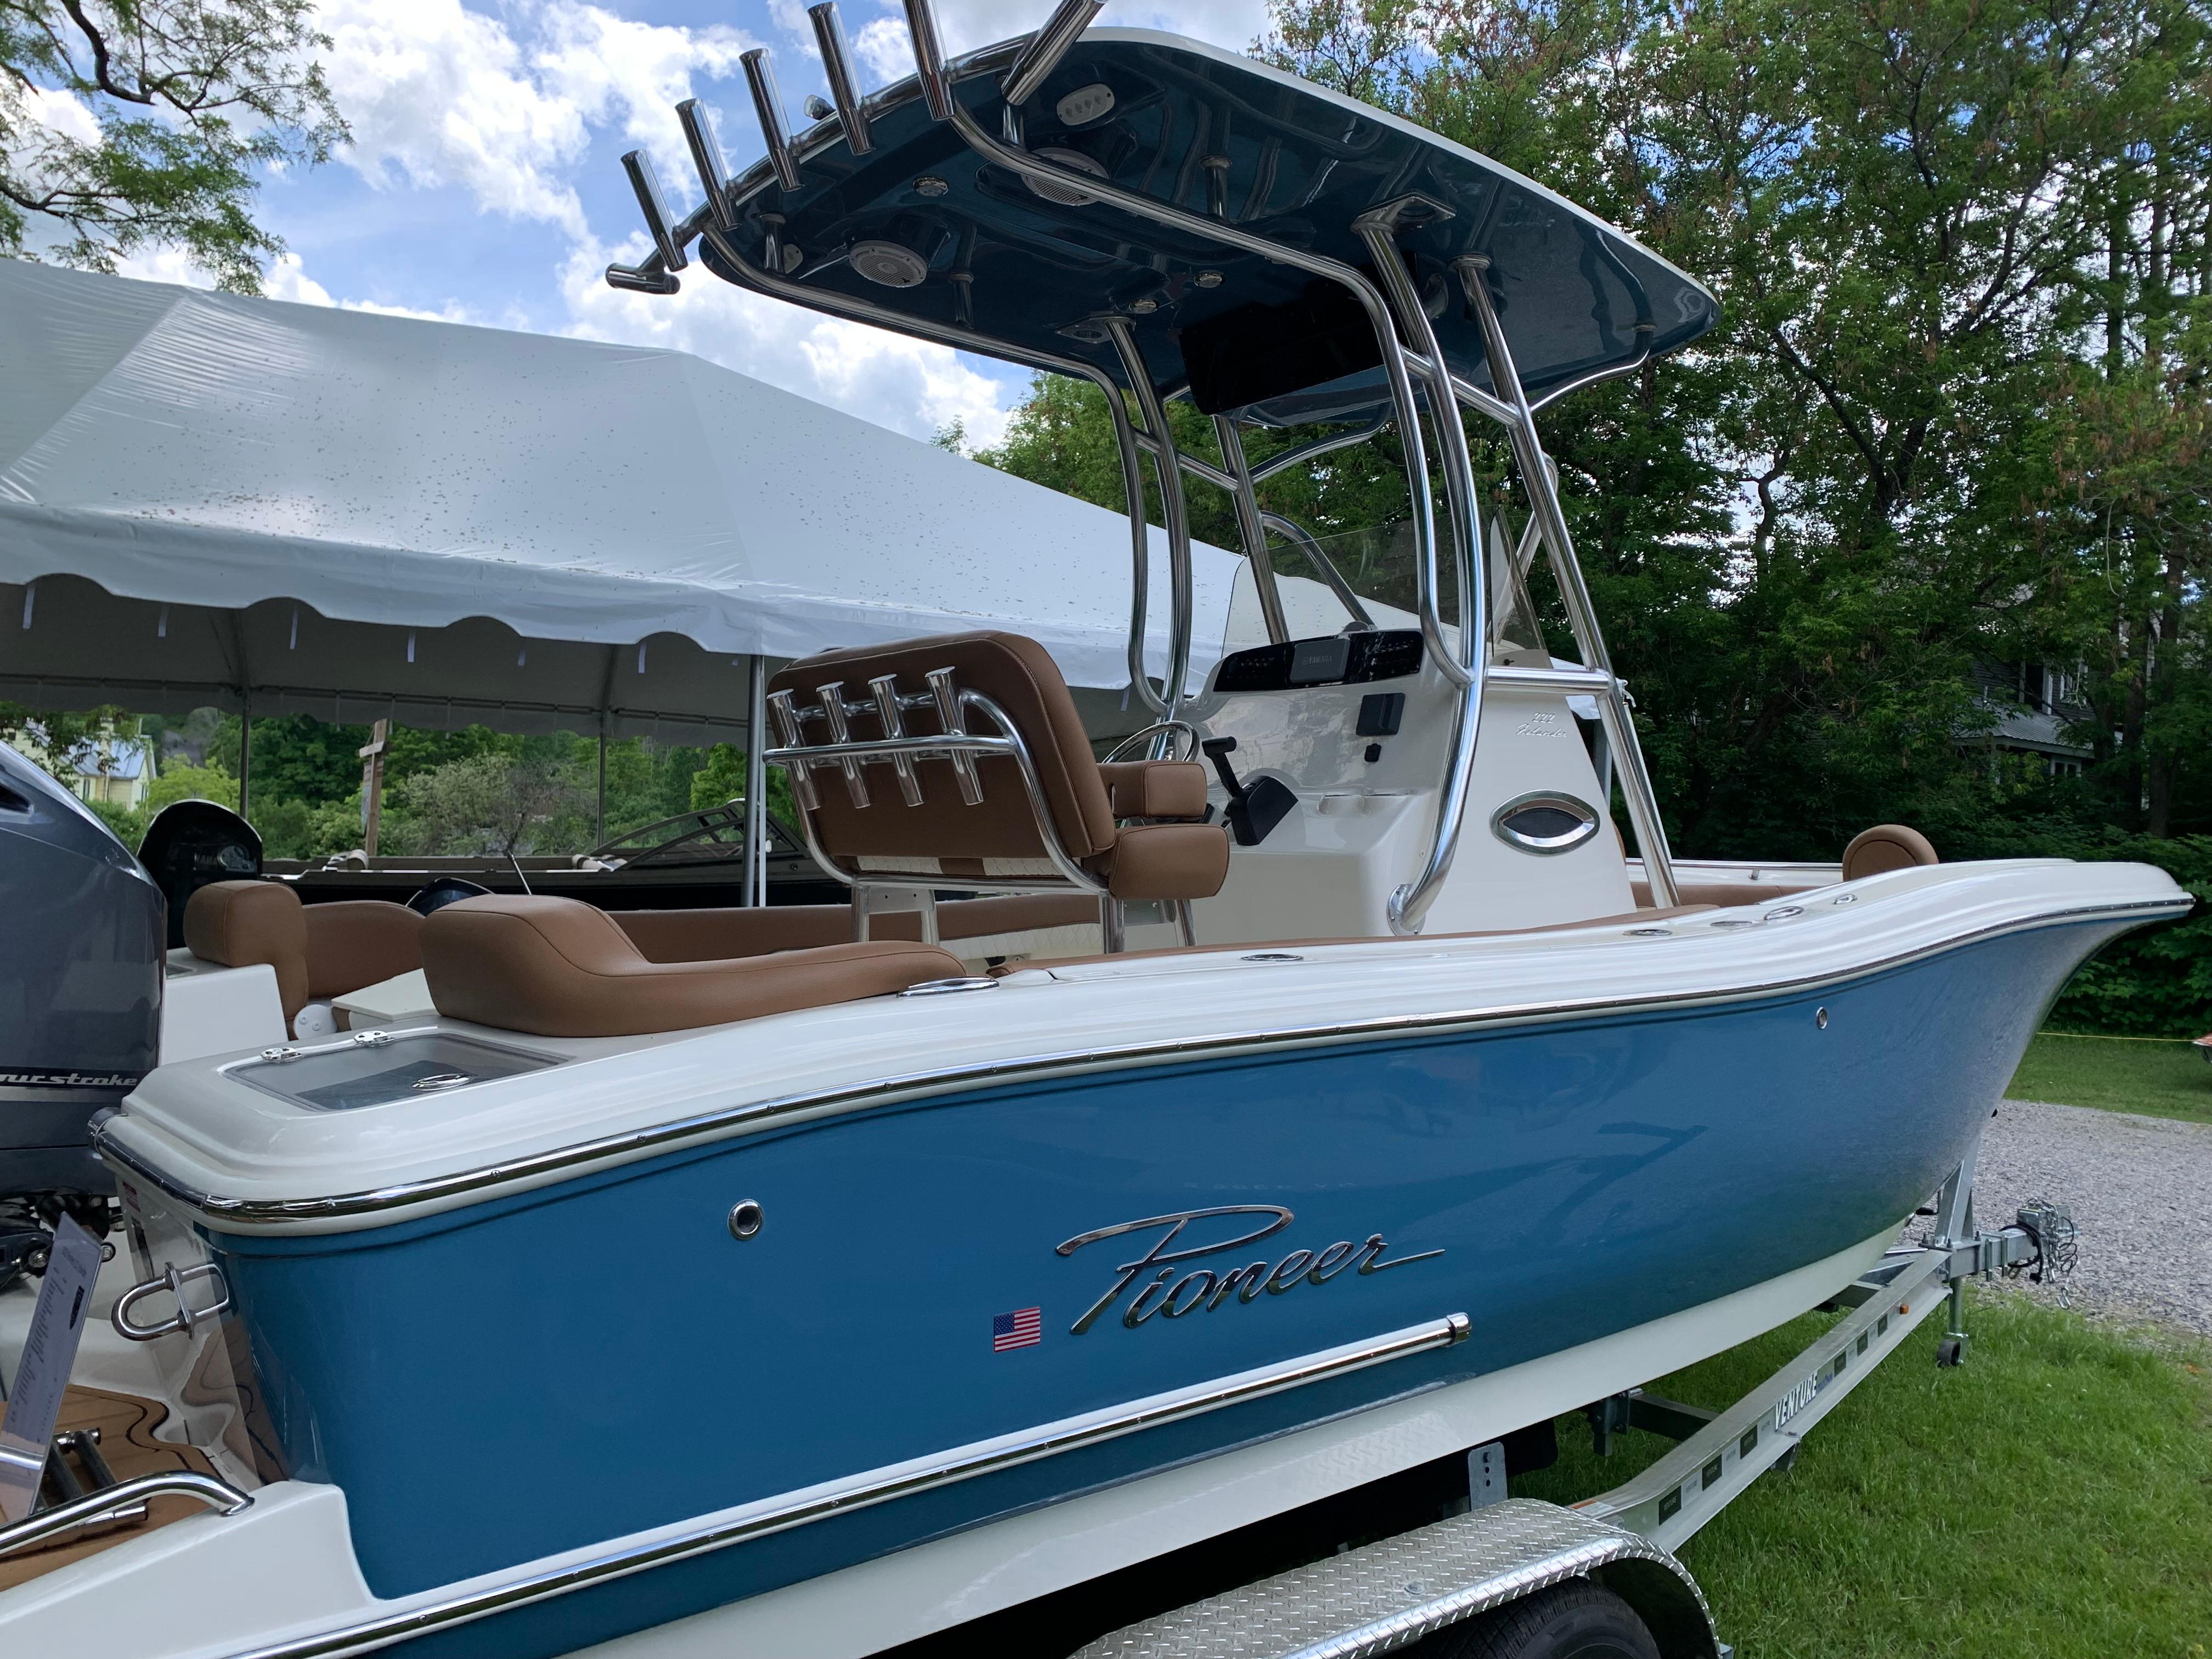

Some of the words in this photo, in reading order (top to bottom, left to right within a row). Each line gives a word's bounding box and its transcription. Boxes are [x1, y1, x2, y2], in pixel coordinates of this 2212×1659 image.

[1532, 712, 1555, 724] 222
[1516, 724, 1567, 737] Islander
[49, 1073, 137, 1086] stroke
[1055, 1204, 1446, 1334] Pioneer
[1774, 1371, 1818, 1432] VENTURE
